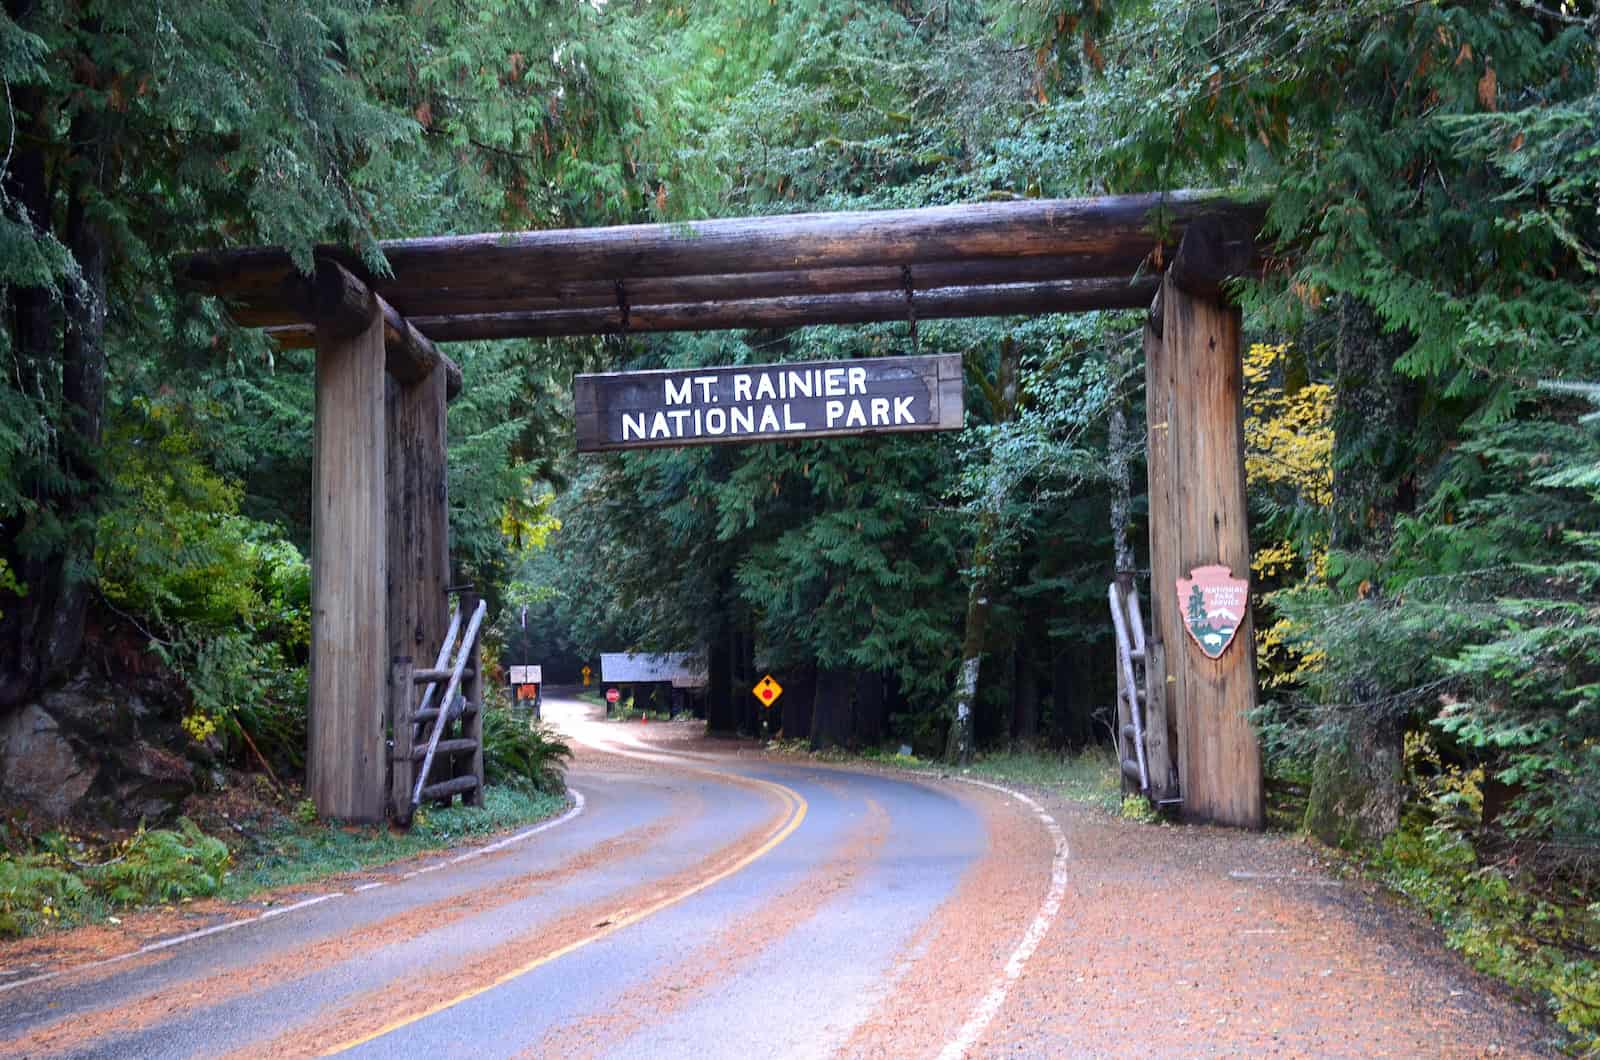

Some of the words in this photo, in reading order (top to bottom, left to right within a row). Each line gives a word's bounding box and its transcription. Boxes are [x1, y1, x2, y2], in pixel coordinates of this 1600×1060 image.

[664, 376, 719, 406] MT.
[733, 367, 868, 402] RAINIER
[621, 403, 807, 441] NATIONAL
[825, 396, 916, 428] PARK
